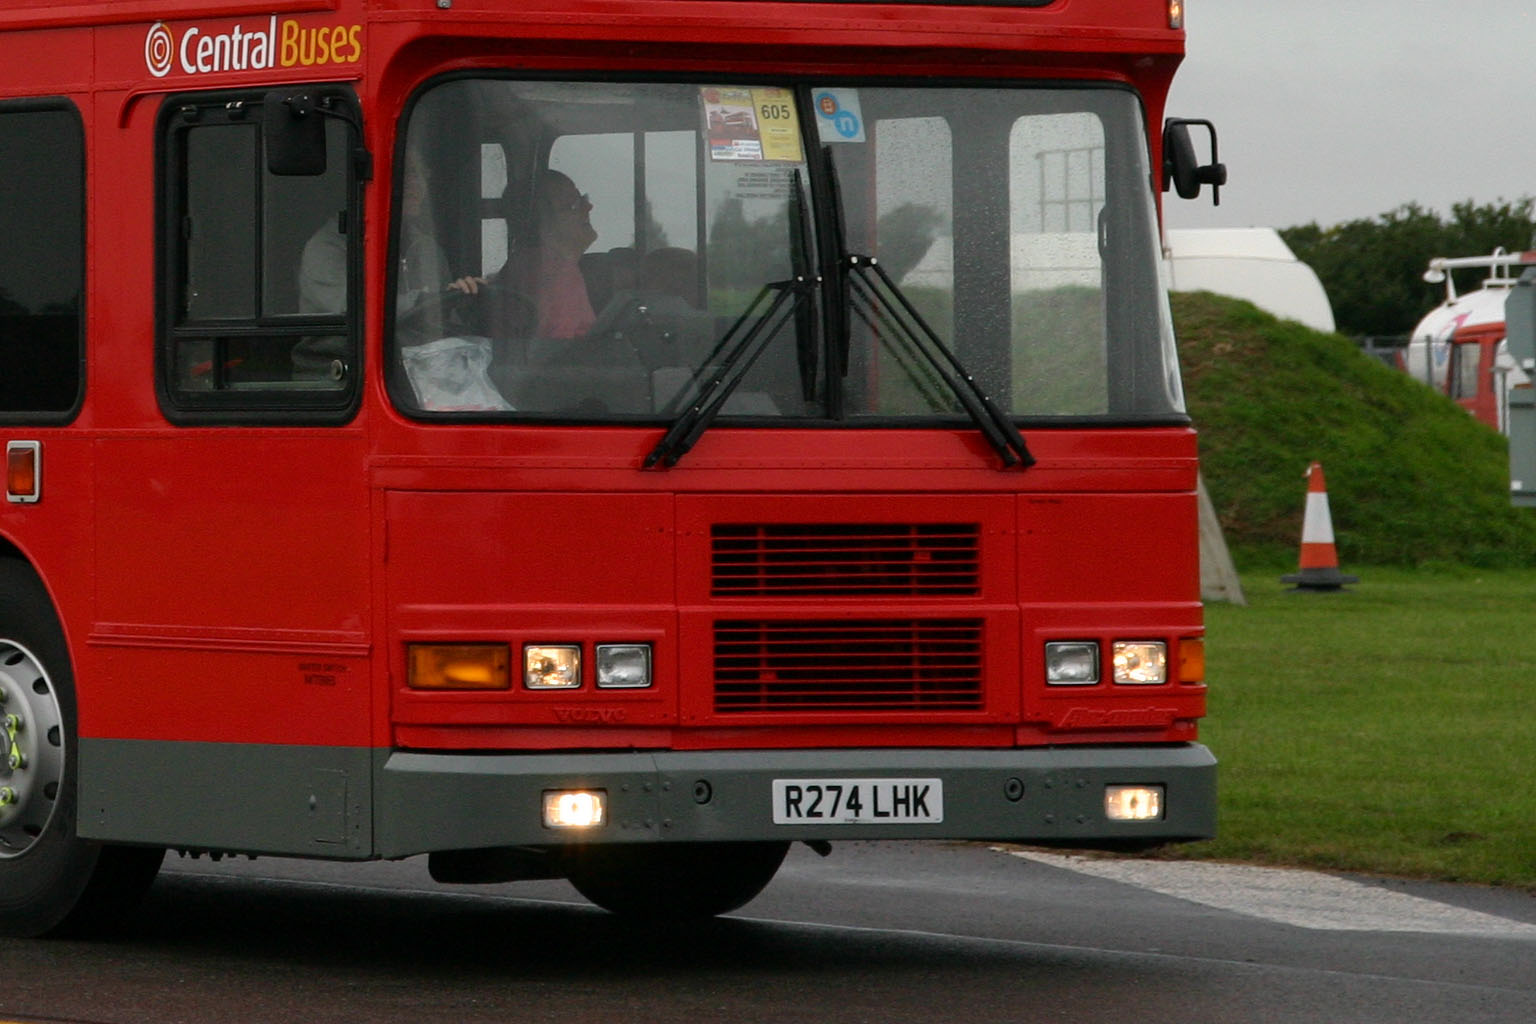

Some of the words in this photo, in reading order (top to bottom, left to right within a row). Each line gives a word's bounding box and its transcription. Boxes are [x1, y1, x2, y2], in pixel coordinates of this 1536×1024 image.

[179, 14, 278, 74] Central
[280, 19, 363, 68] Buses
[760, 104, 791, 121] 605
[785, 784, 863, 818] R274
[872, 784, 931, 818] LHK
